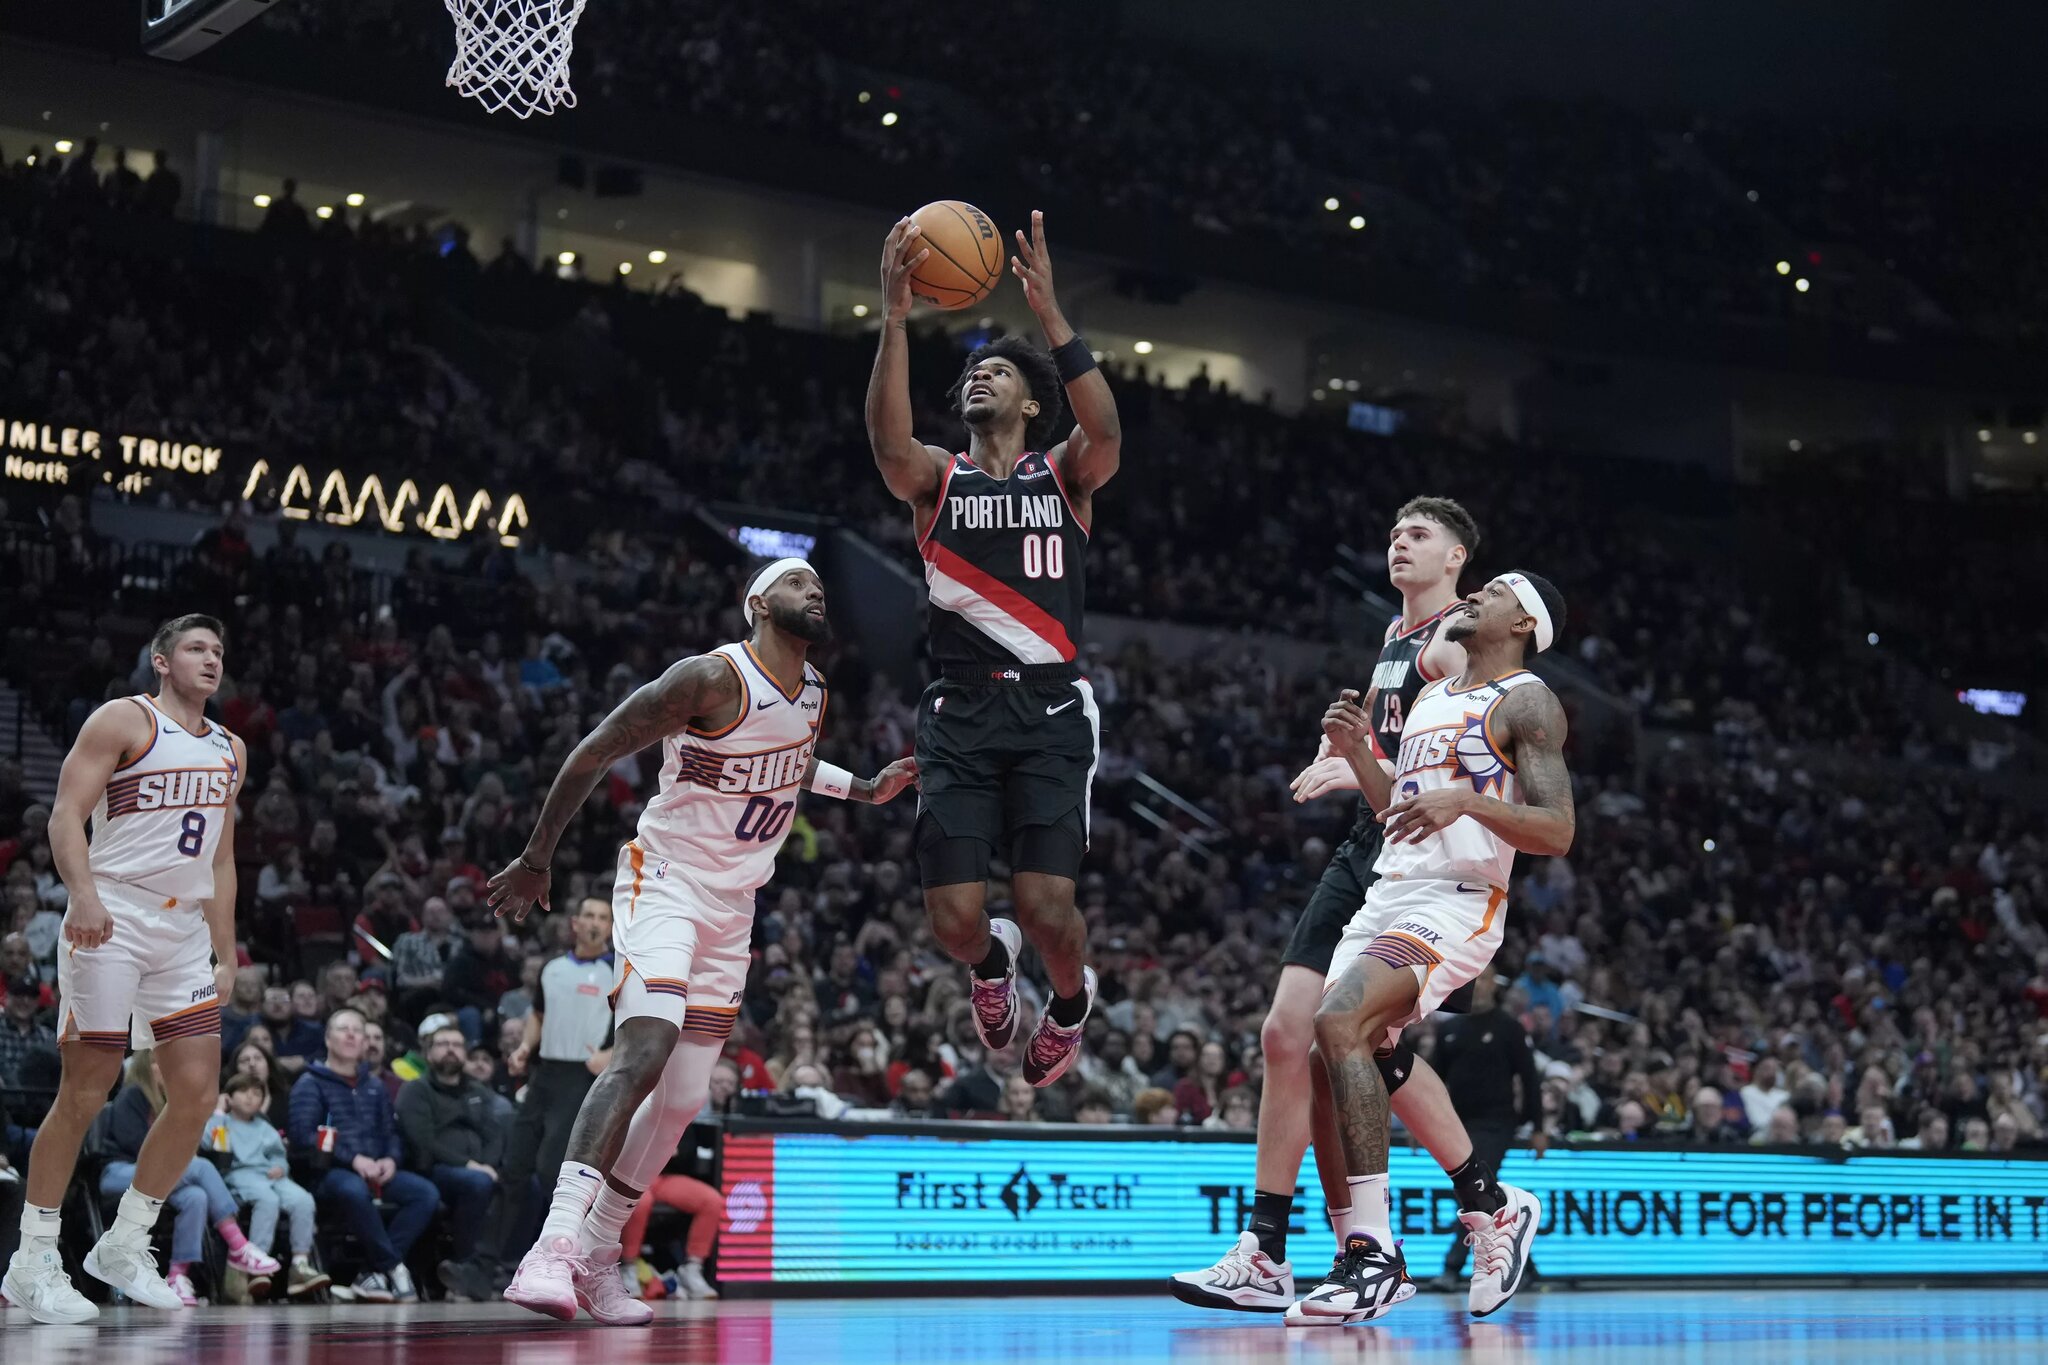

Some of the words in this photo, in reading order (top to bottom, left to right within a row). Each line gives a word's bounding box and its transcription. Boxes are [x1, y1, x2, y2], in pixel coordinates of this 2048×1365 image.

[5, 454, 68, 485] North
[119, 435, 222, 475] TRUCK
[949, 494, 1064, 530] PORTLAND
[1023, 534, 1064, 579] 00
[991, 669, 1021, 682] ripcity
[1465, 693, 1491, 703] PayPal
[717, 744, 811, 793] SUNS
[1395, 729, 1457, 780] UNS
[136, 771, 227, 811] SUNS
[177, 810, 207, 858] 8
[734, 796, 794, 842] 00
[896, 1171, 988, 1210] First
[1536, 1190, 1682, 1236] UNION
[1699, 1191, 1788, 1236] FOR
[1803, 1193, 1961, 1238] PEOPLE
[1976, 1195, 2013, 1238] IN
[2024, 1196, 2048, 1238] T
